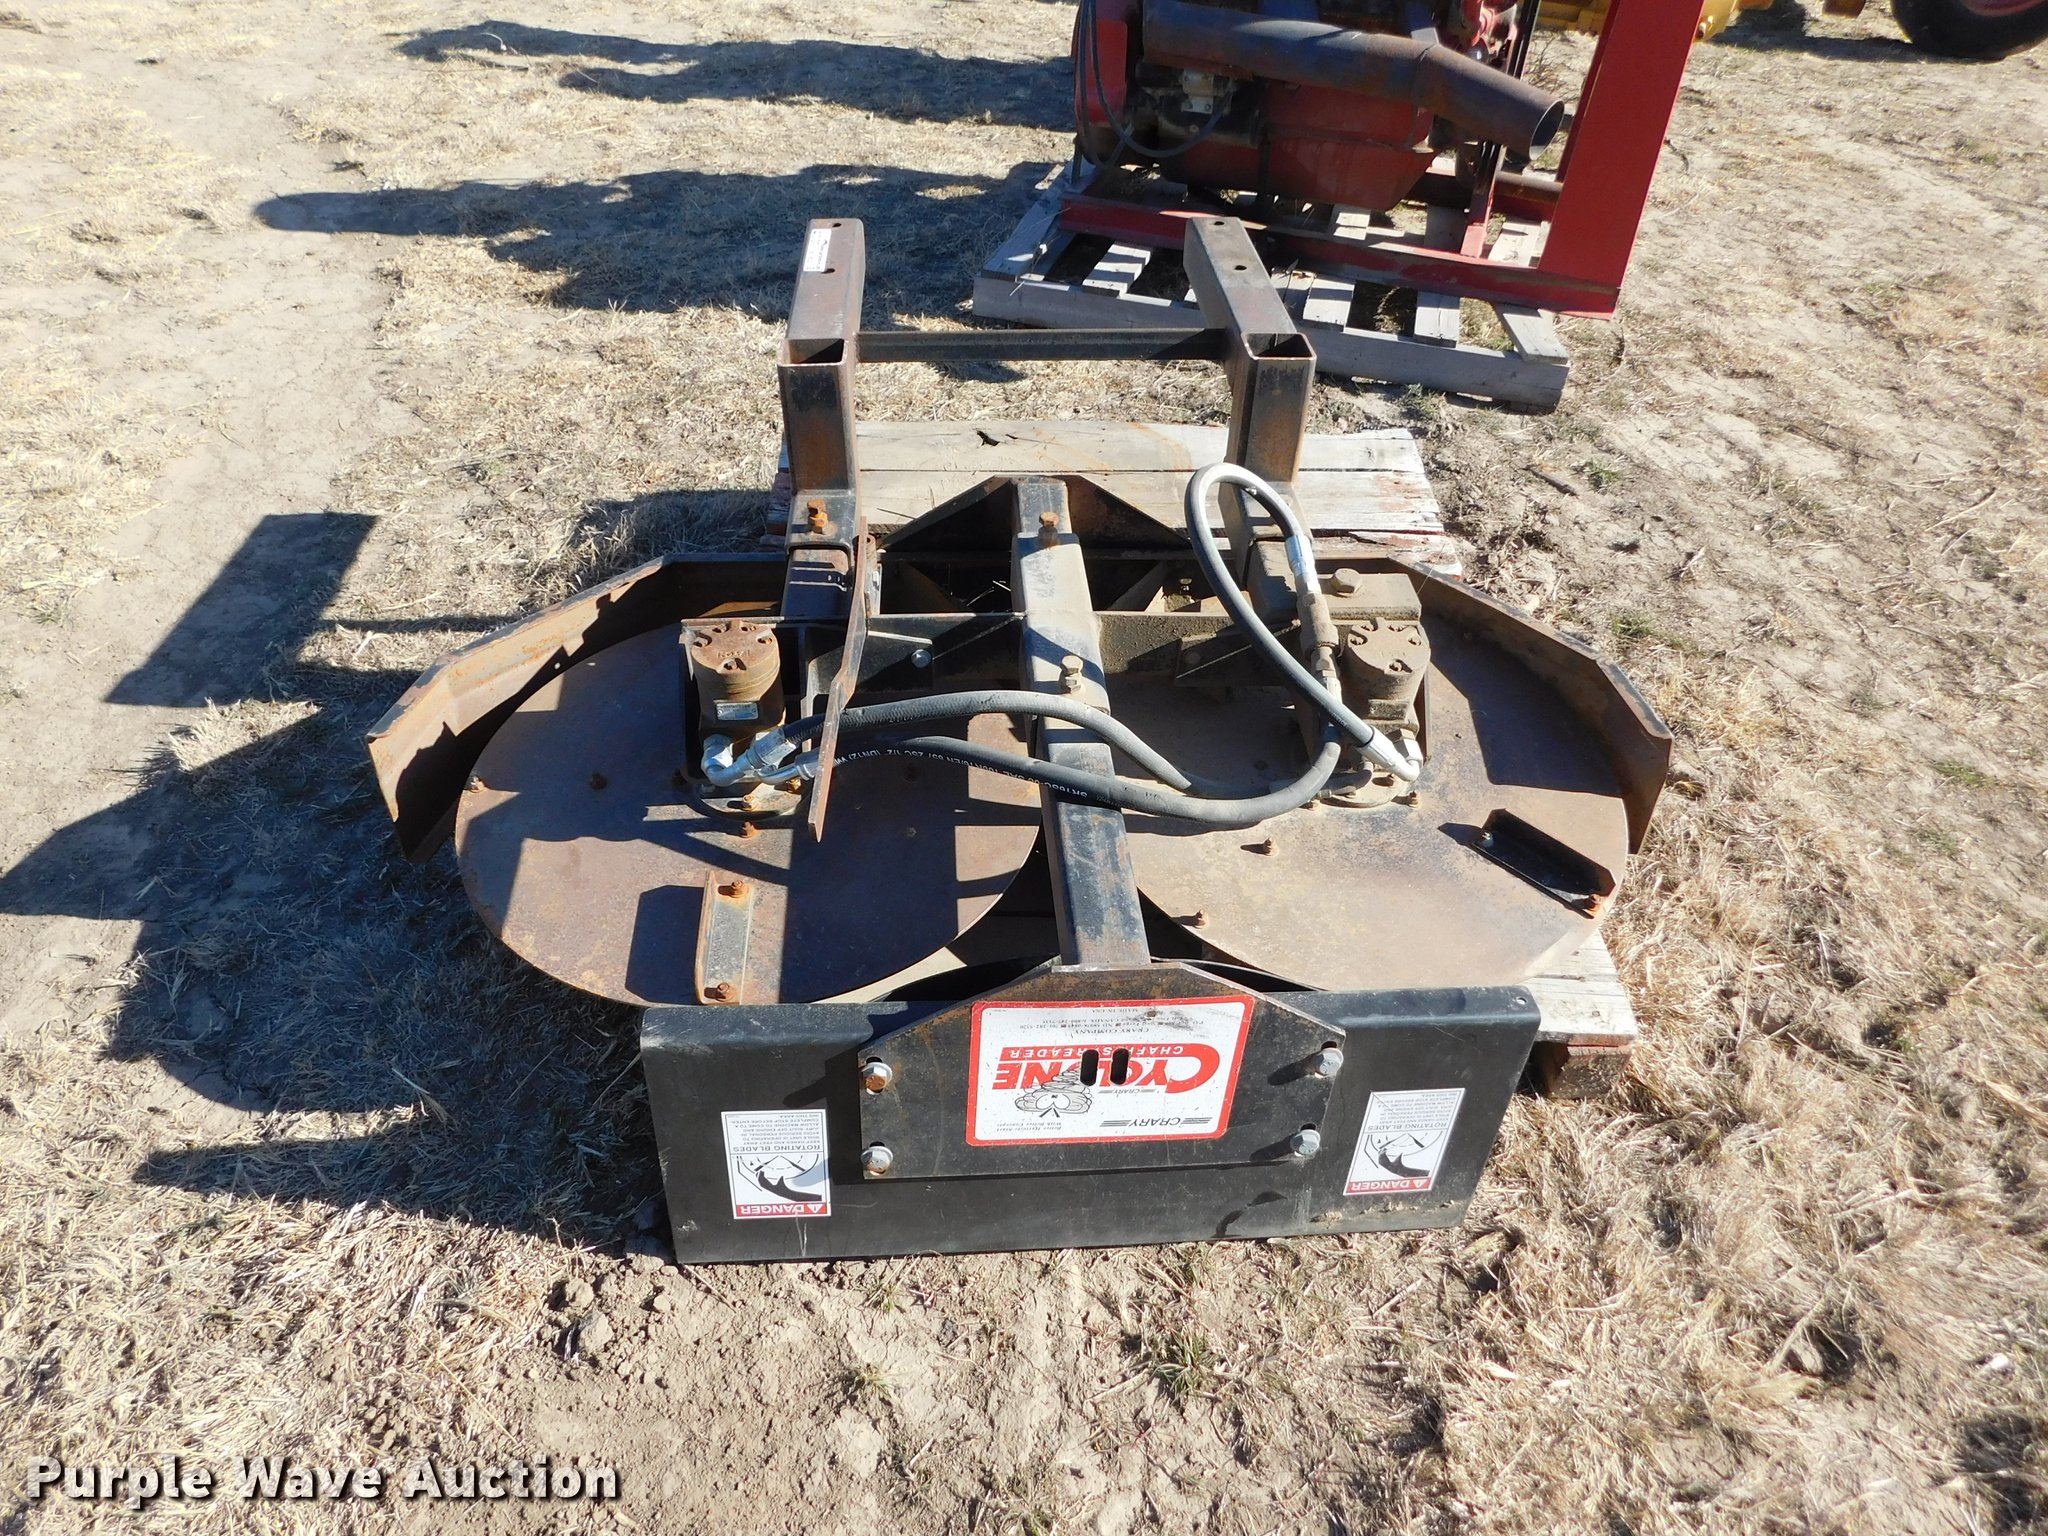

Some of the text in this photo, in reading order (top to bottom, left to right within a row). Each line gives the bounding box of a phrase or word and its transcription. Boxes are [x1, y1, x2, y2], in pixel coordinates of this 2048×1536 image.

[1009, 1046, 1112, 1058] SREADER
[1128, 1116, 1182, 1128] CRARY
[1351, 1180, 1410, 1190] DANGER
[740, 1204, 804, 1214] DANGER
